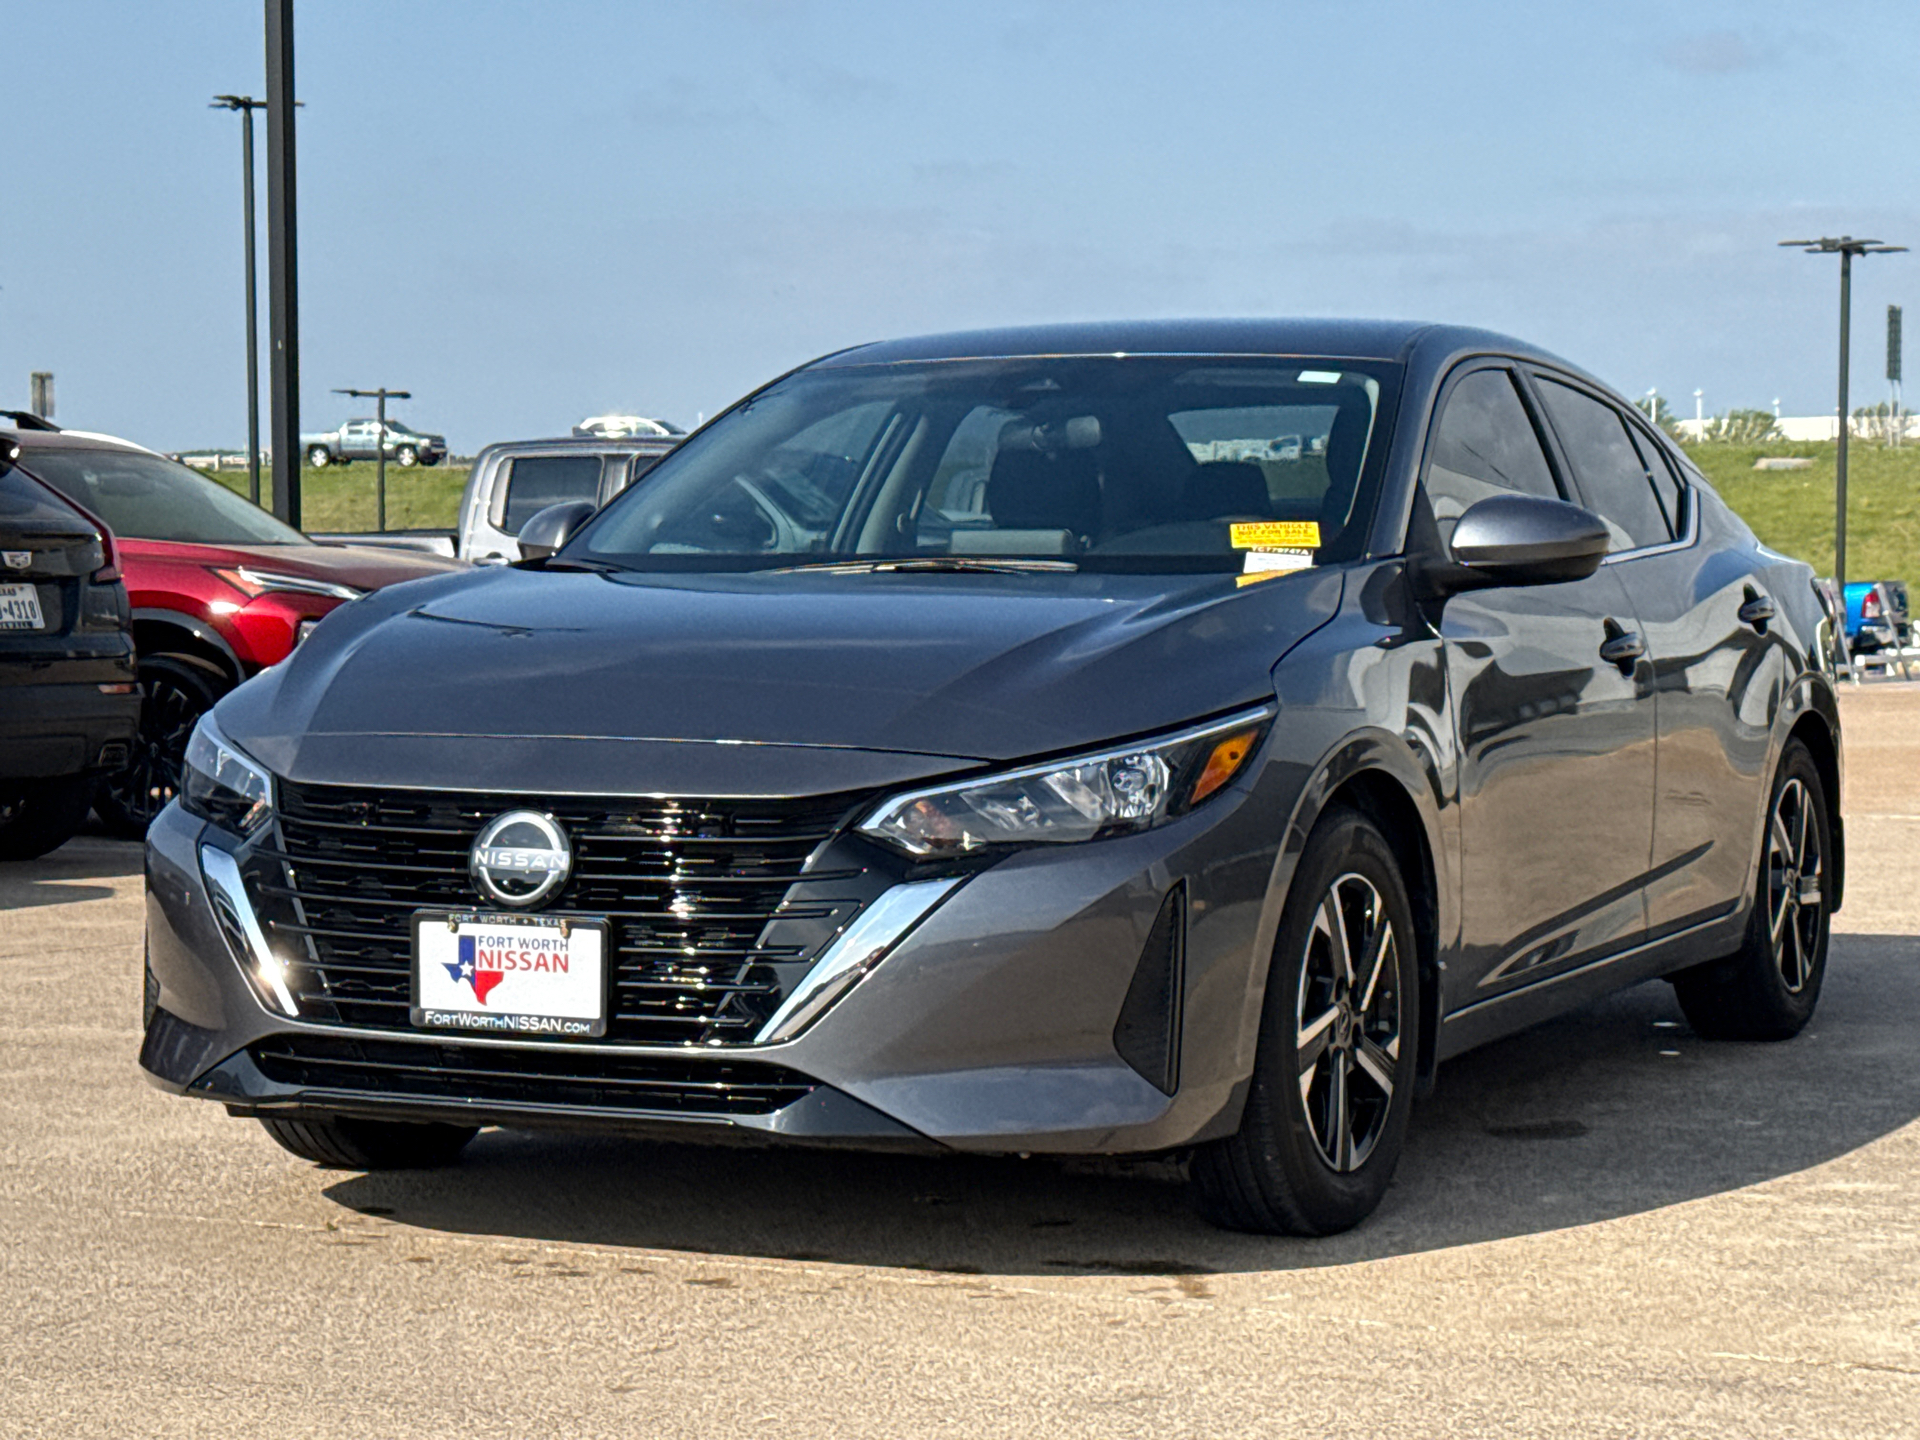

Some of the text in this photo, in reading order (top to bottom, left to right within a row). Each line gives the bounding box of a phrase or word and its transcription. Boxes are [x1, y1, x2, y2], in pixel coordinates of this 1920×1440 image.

[1263, 522, 1313, 530] VEHICLE
[474, 850, 567, 869] NISSAN
[449, 914, 567, 928] FORT WORTH TEXAS
[478, 935, 569, 952] FORT WORTH
[478, 949, 569, 973] NISSAN
